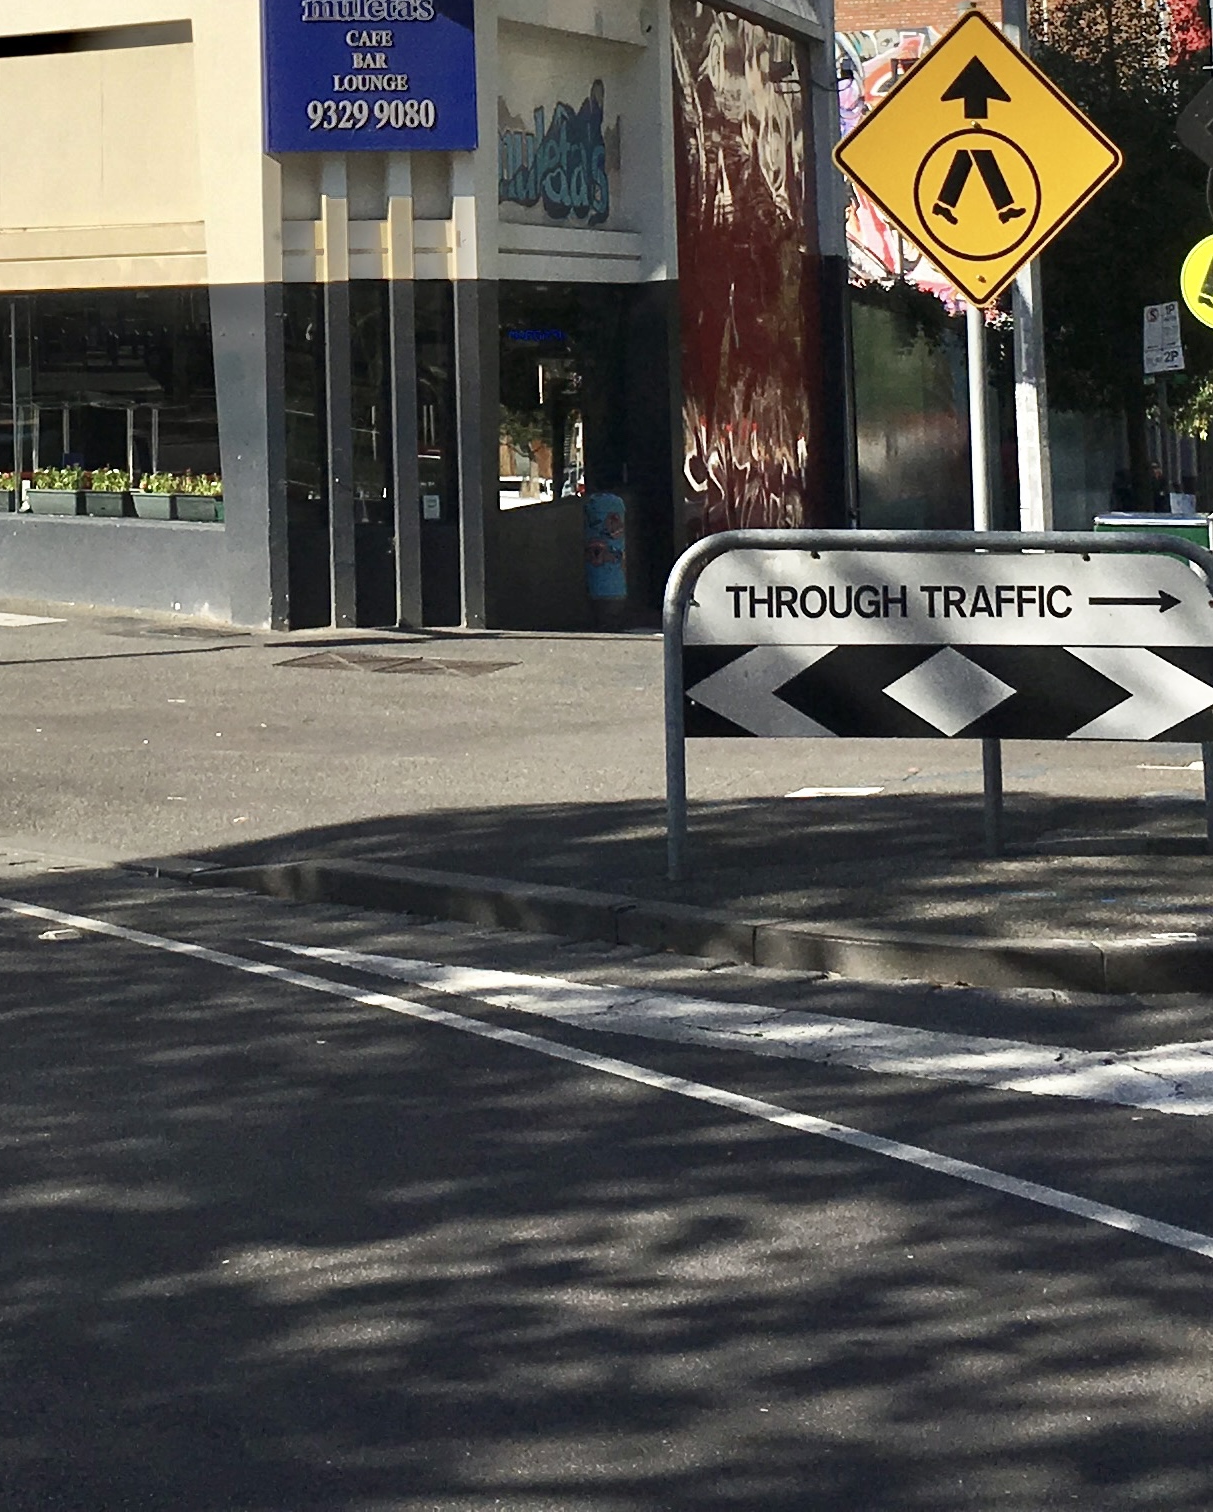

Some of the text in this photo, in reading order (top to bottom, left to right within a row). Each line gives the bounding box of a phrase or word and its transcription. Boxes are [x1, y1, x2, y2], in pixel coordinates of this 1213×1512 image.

[346, 29, 393, 47] CAFE
[351, 52, 388, 69] BAR
[333, 74, 409, 91] LOUNGE
[307, 99, 436, 130] 9329 9080
[1164, 351, 1179, 363] 2P
[725, 584, 1073, 619] THROUGH TRAFFIC
